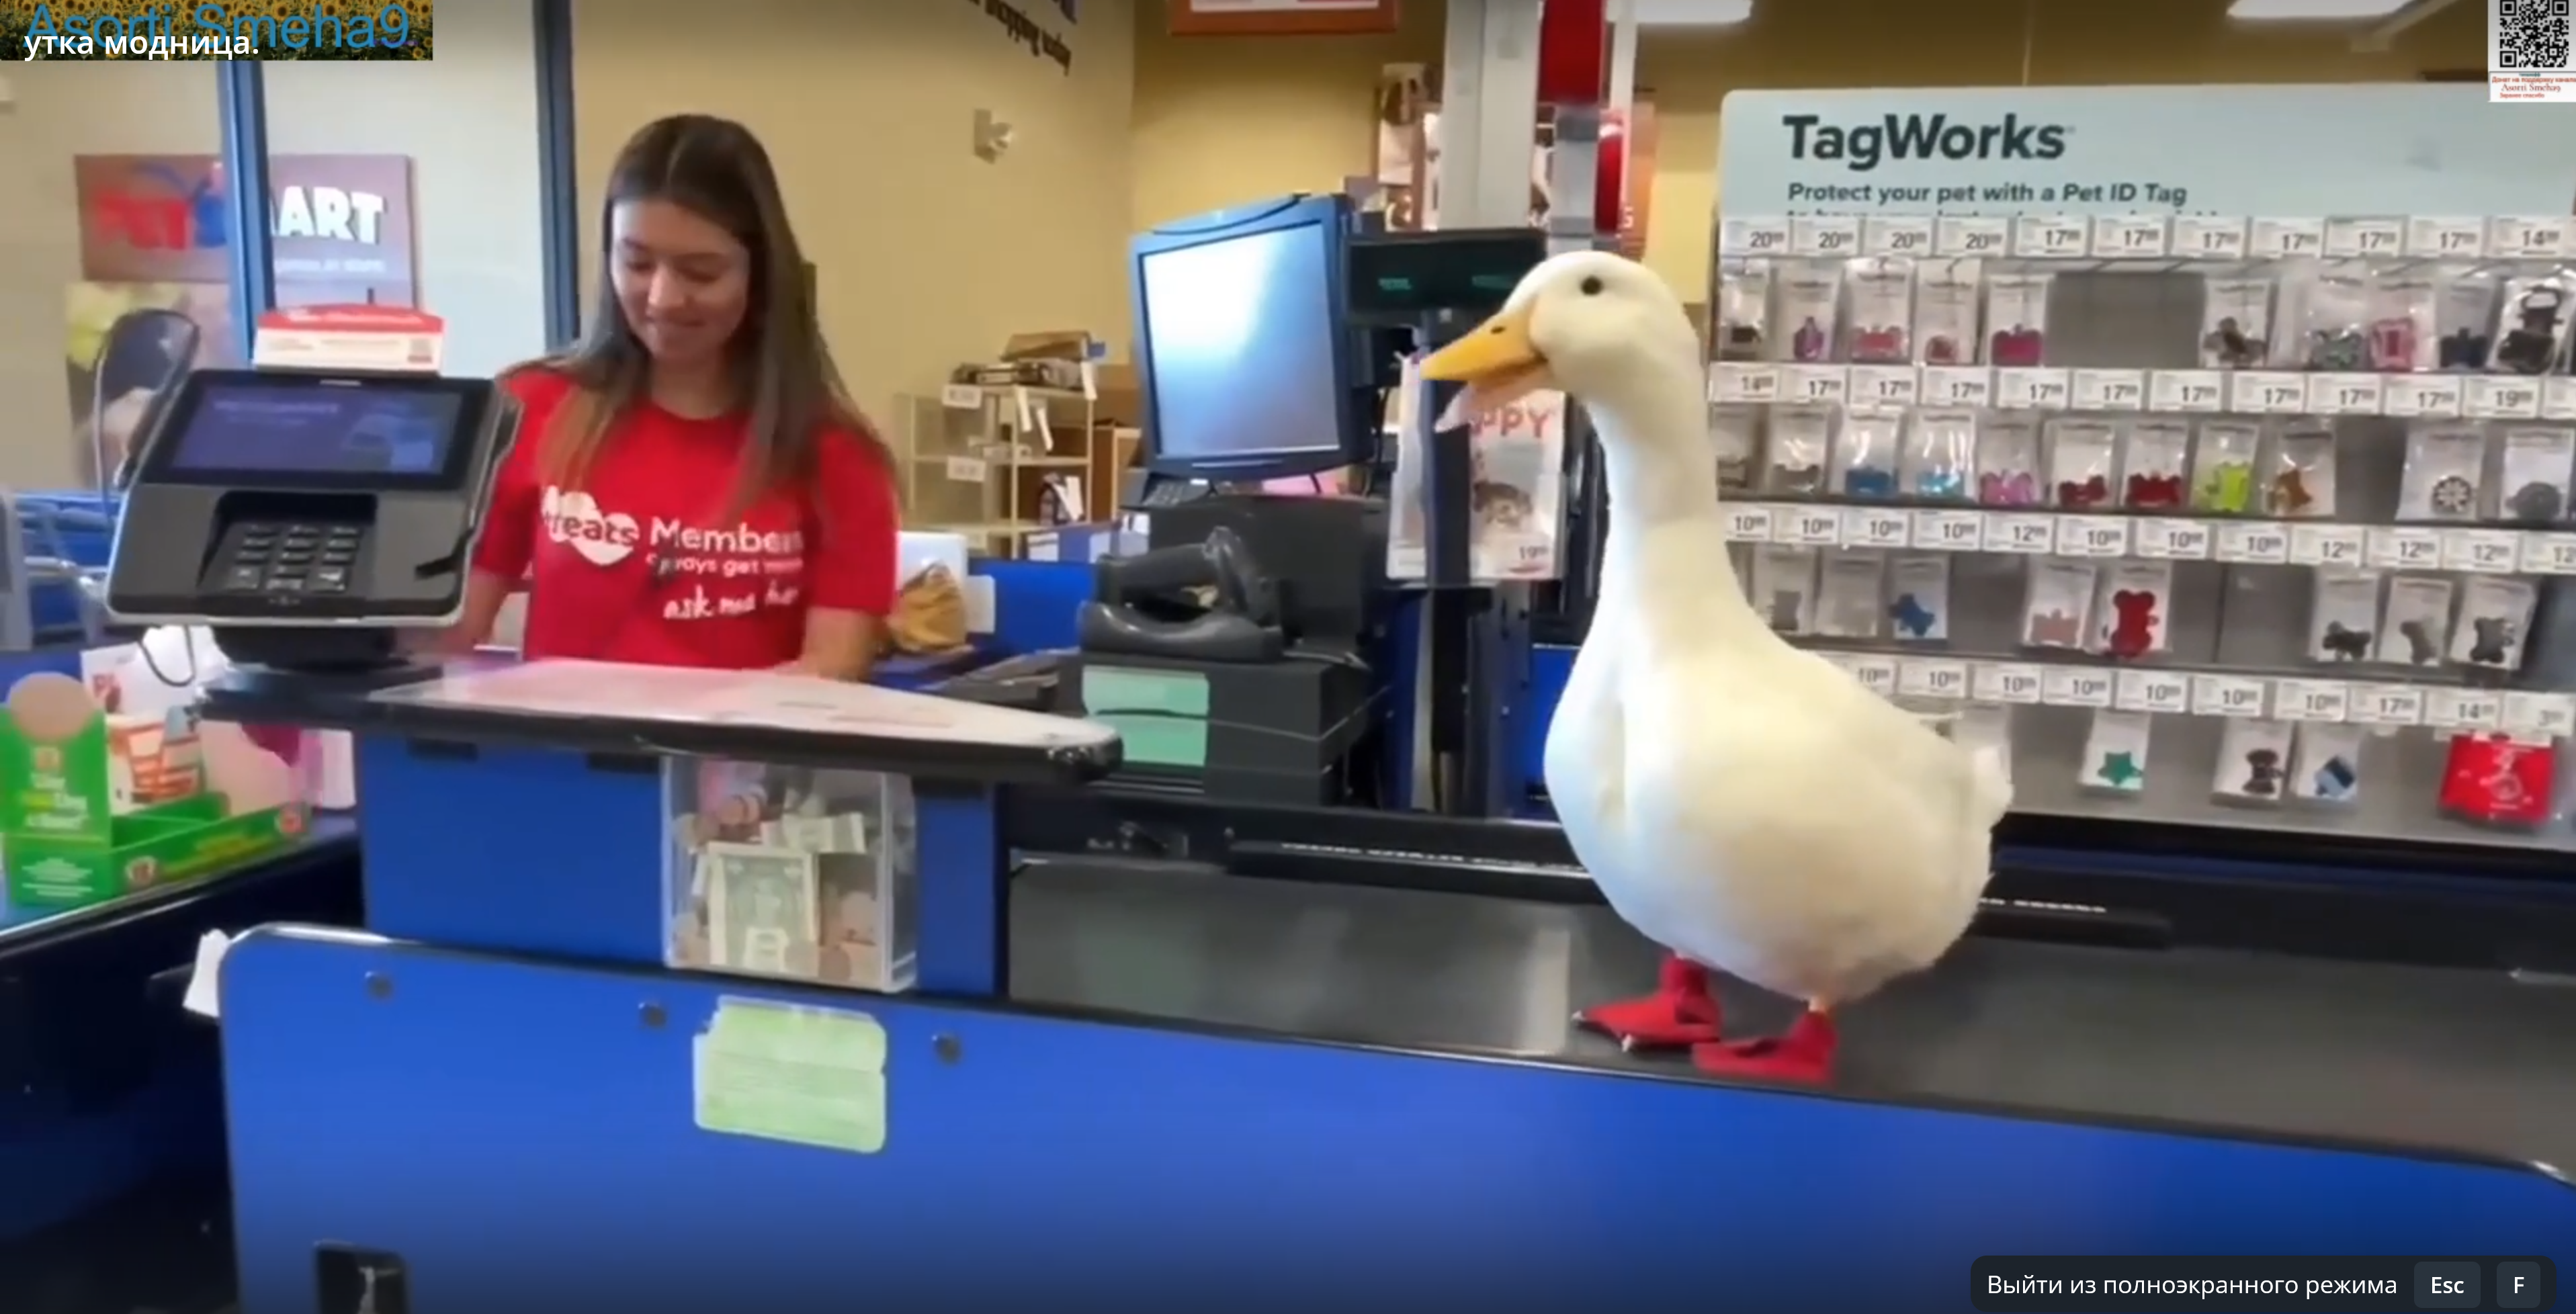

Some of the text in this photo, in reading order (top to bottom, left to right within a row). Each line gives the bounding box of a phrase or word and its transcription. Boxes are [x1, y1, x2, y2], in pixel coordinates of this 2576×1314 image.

[1783, 114, 2065, 171] TagWorks
[92, 186, 384, 251] PETART
[1788, 182, 2187, 206] Protect your pet with a Pet ID Tag
